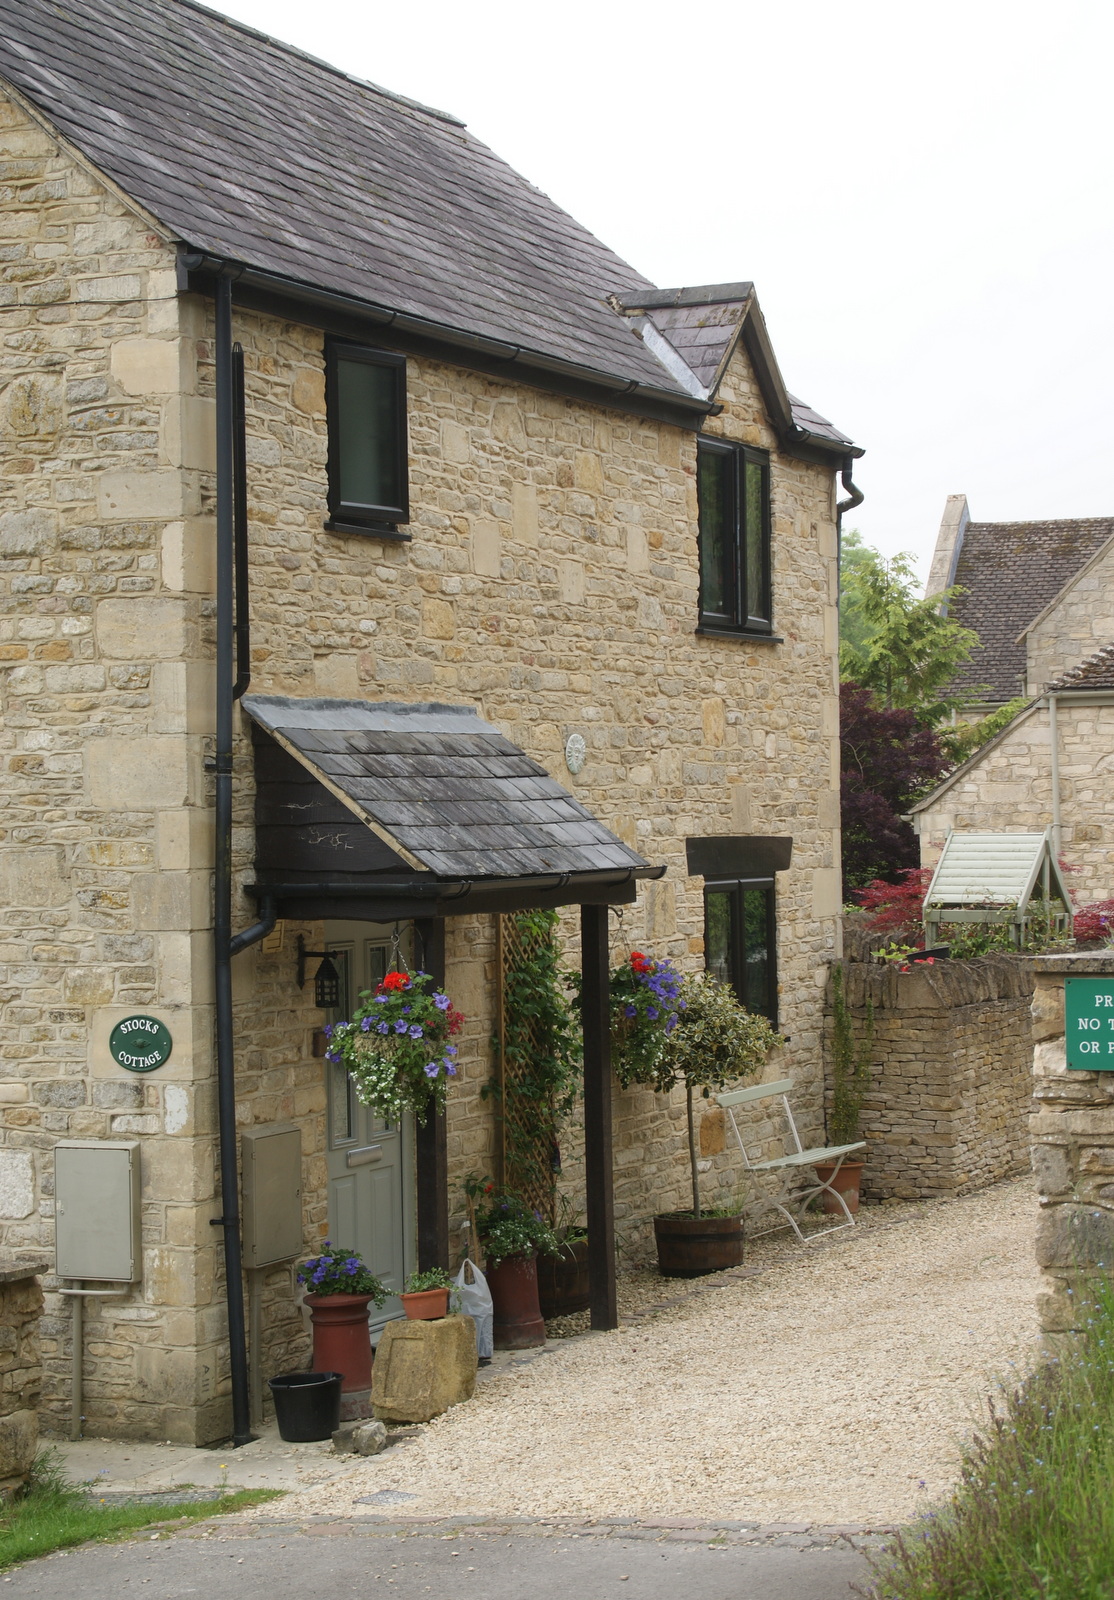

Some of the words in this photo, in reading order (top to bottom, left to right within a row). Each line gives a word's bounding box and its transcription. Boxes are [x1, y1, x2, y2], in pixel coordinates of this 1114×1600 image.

[120, 1019, 159, 1034] STOCKS
[1077, 1018, 1101, 1031] NO
[1079, 1041, 1101, 1054] OR
[118, 1050, 162, 1068] COTTAGE
